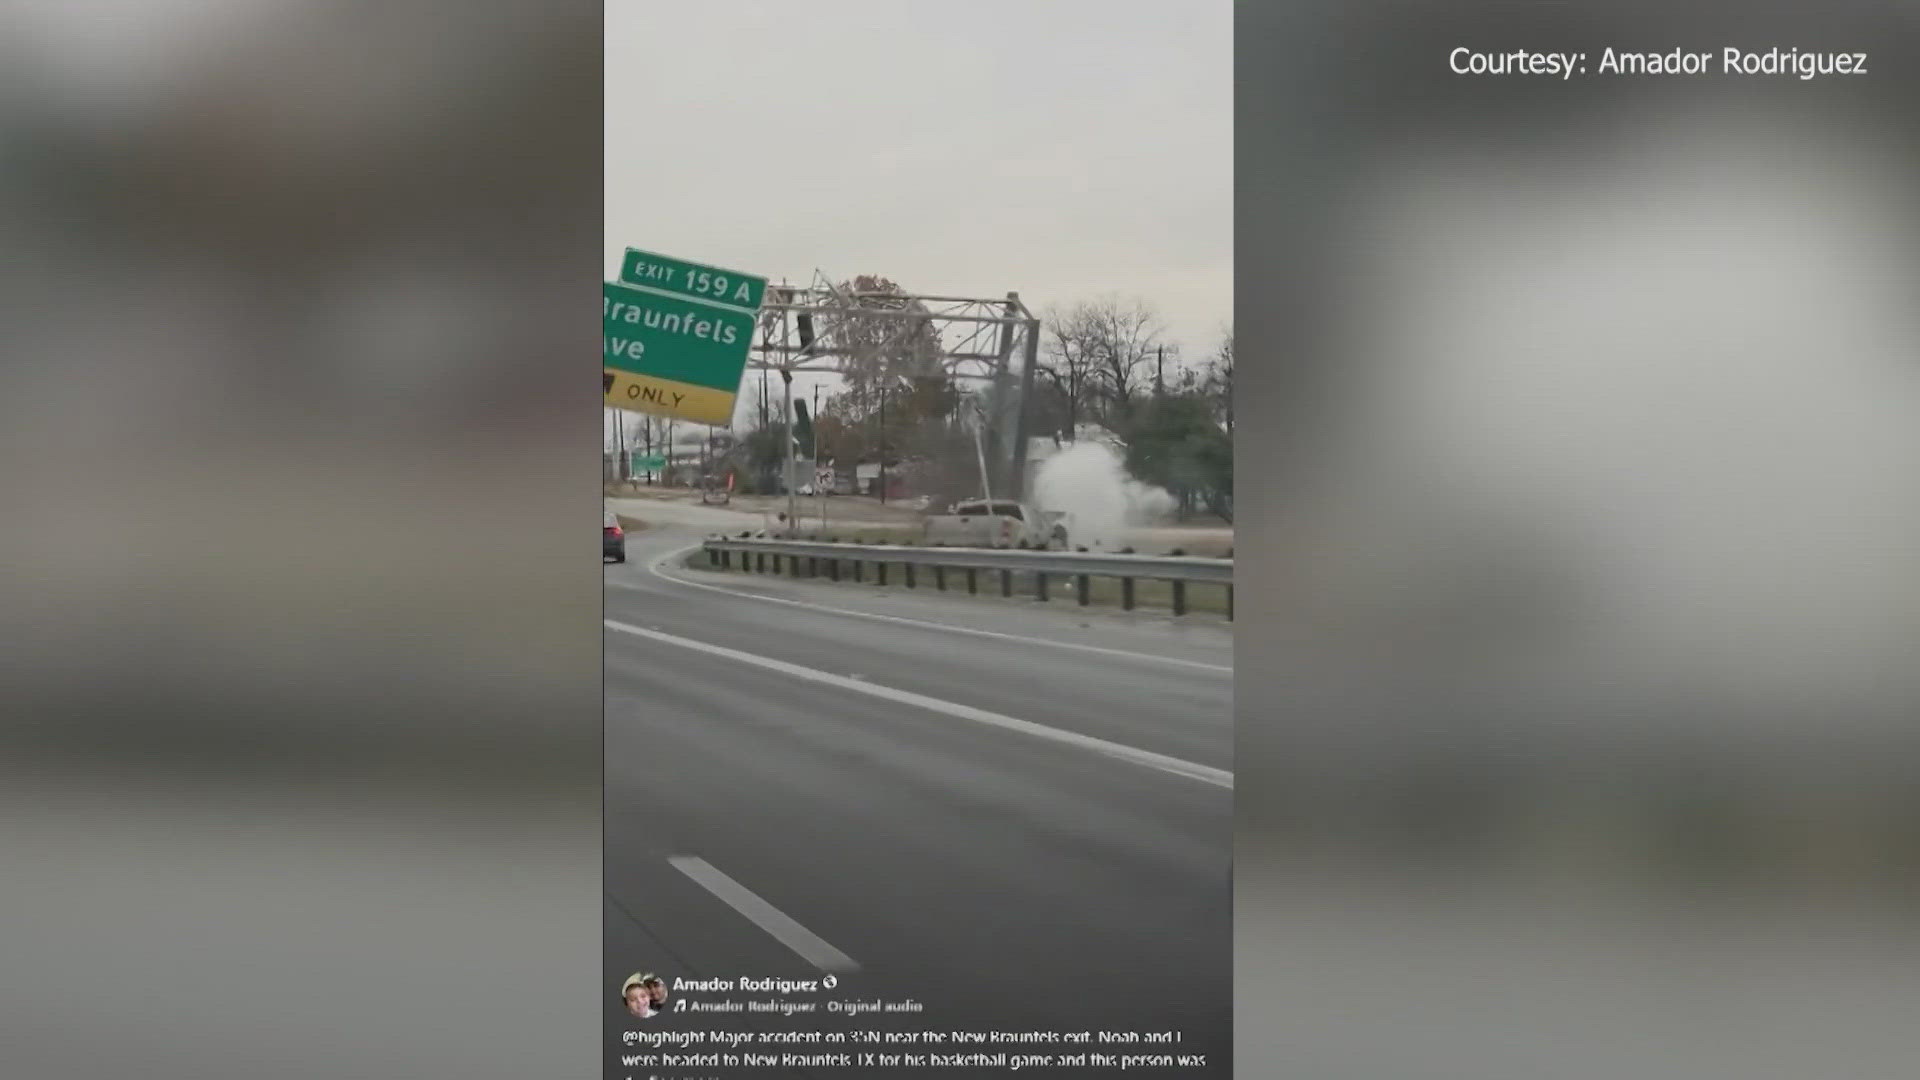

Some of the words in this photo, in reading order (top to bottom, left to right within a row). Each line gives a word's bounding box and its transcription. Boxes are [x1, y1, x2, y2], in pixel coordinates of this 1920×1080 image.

[634, 261, 675, 282] EXIT
[686, 269, 729, 298] 159
[604, 335, 646, 360] ve
[627, 384, 686, 408] ONLY
